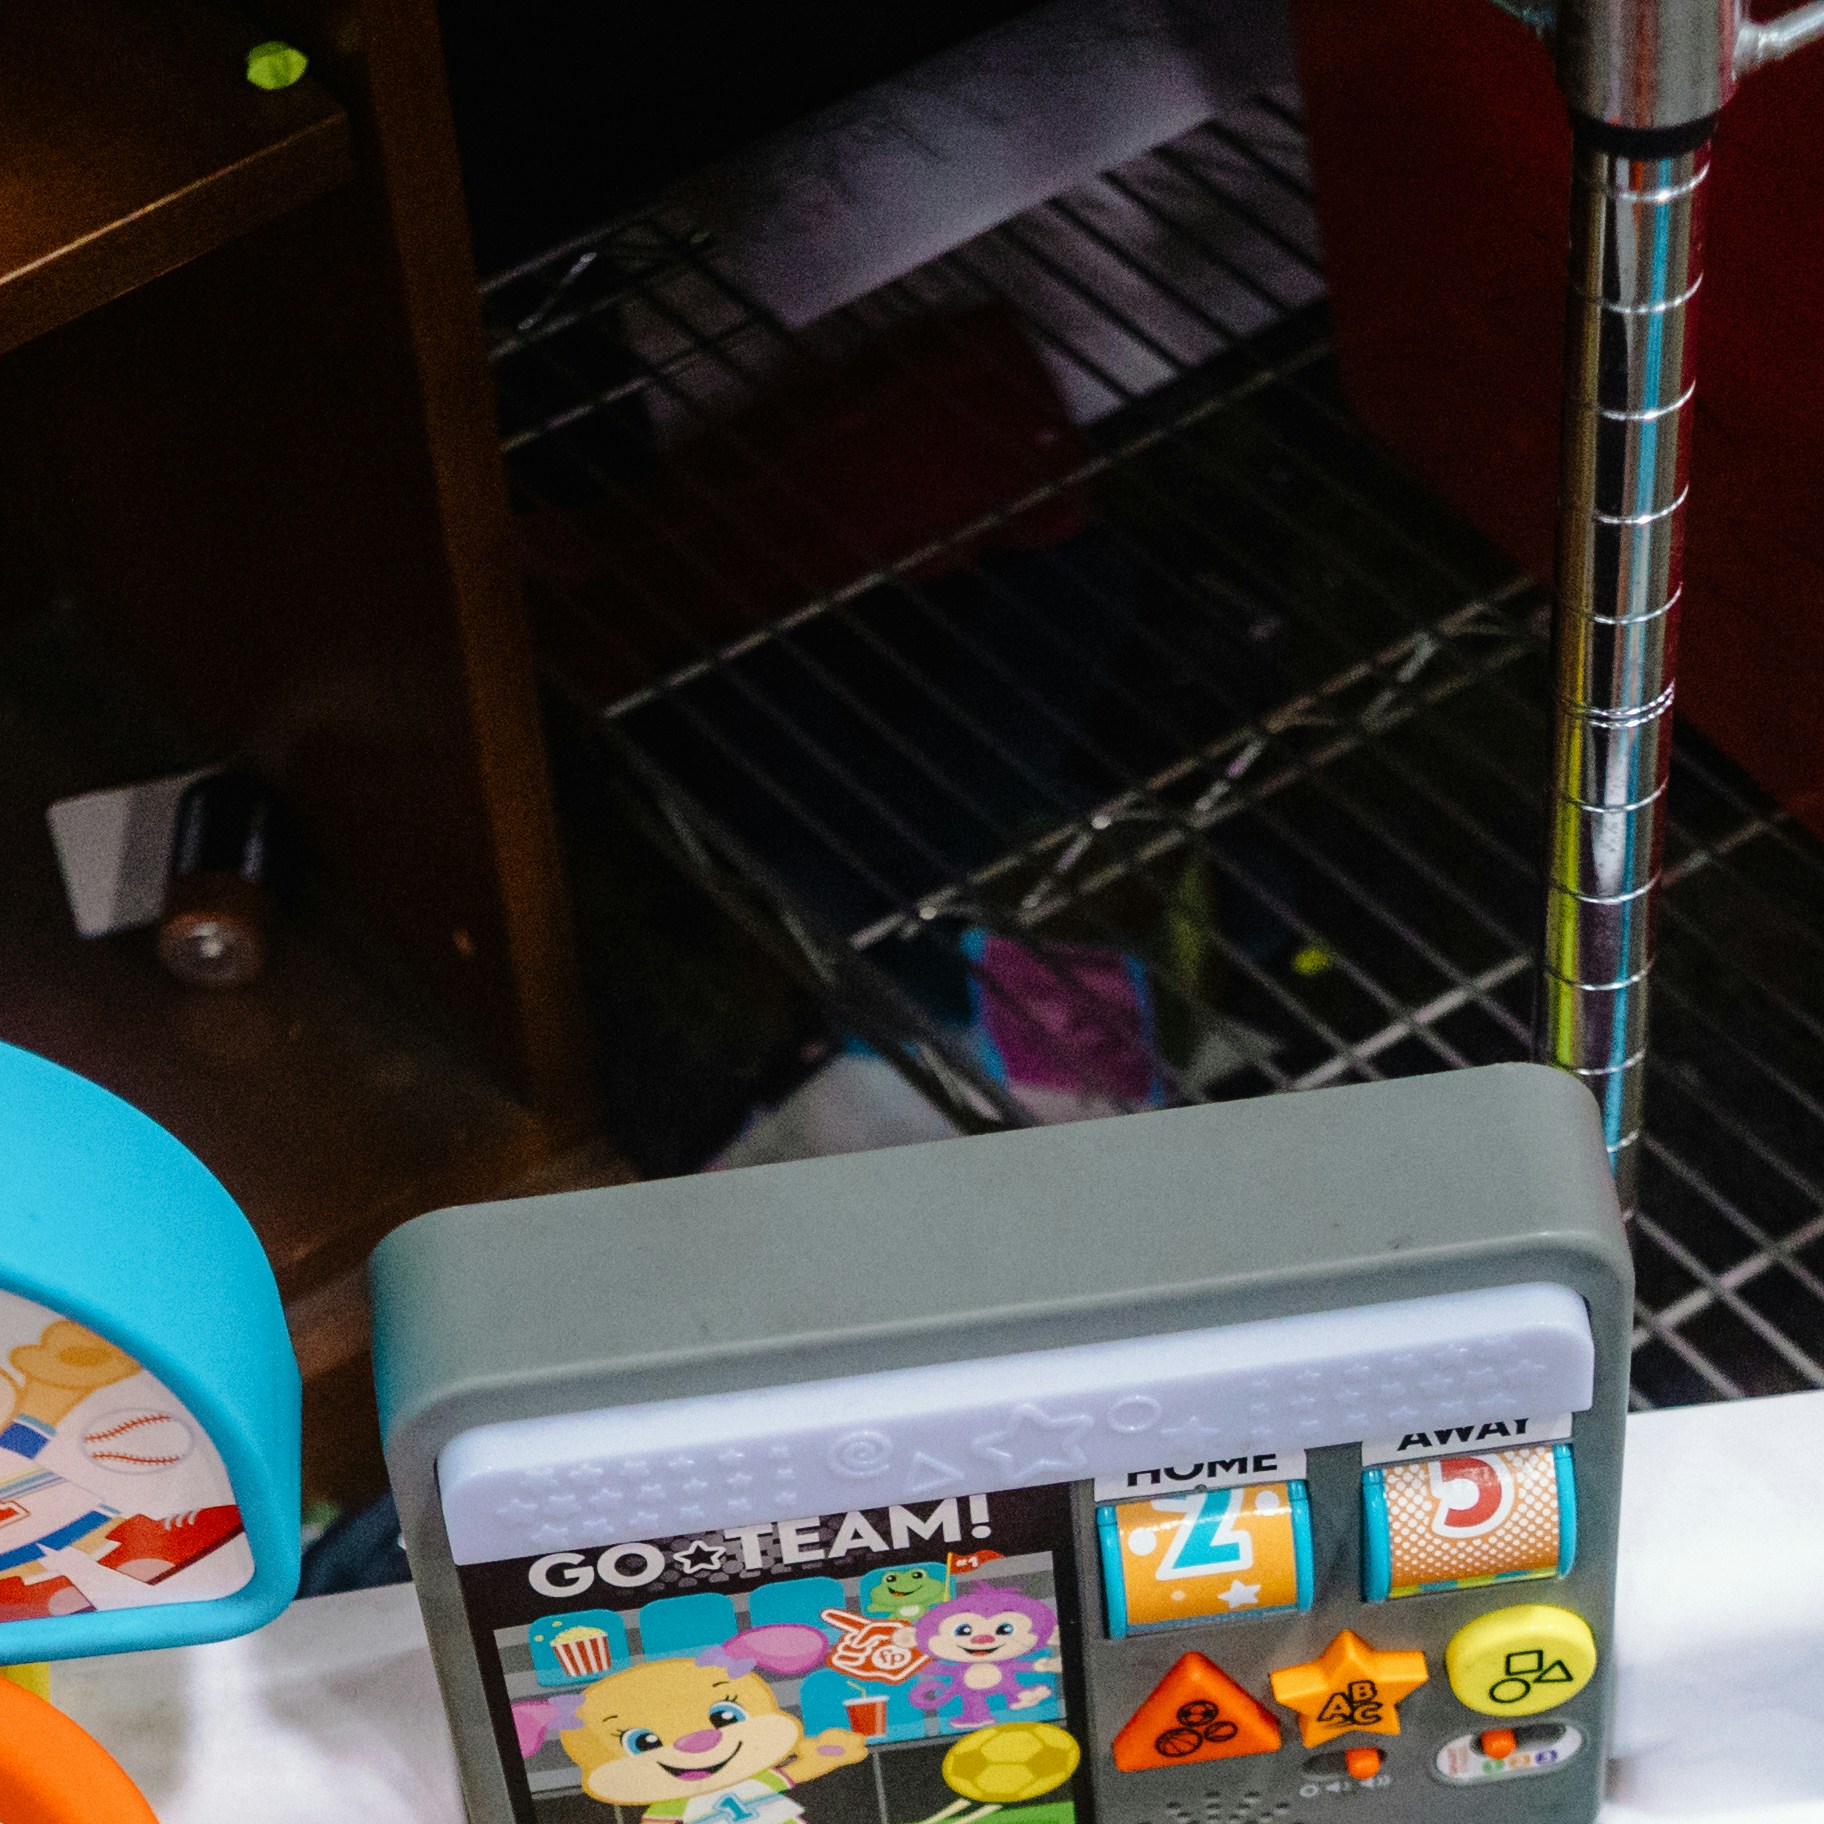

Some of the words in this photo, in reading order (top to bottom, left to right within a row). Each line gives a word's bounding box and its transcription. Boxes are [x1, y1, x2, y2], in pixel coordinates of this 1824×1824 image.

[1397, 1416, 1532, 1452] AWAY
[1126, 1453, 1278, 1488] HOME
[527, 1540, 666, 1600] GO
[726, 1493, 994, 1568] TEAM!
